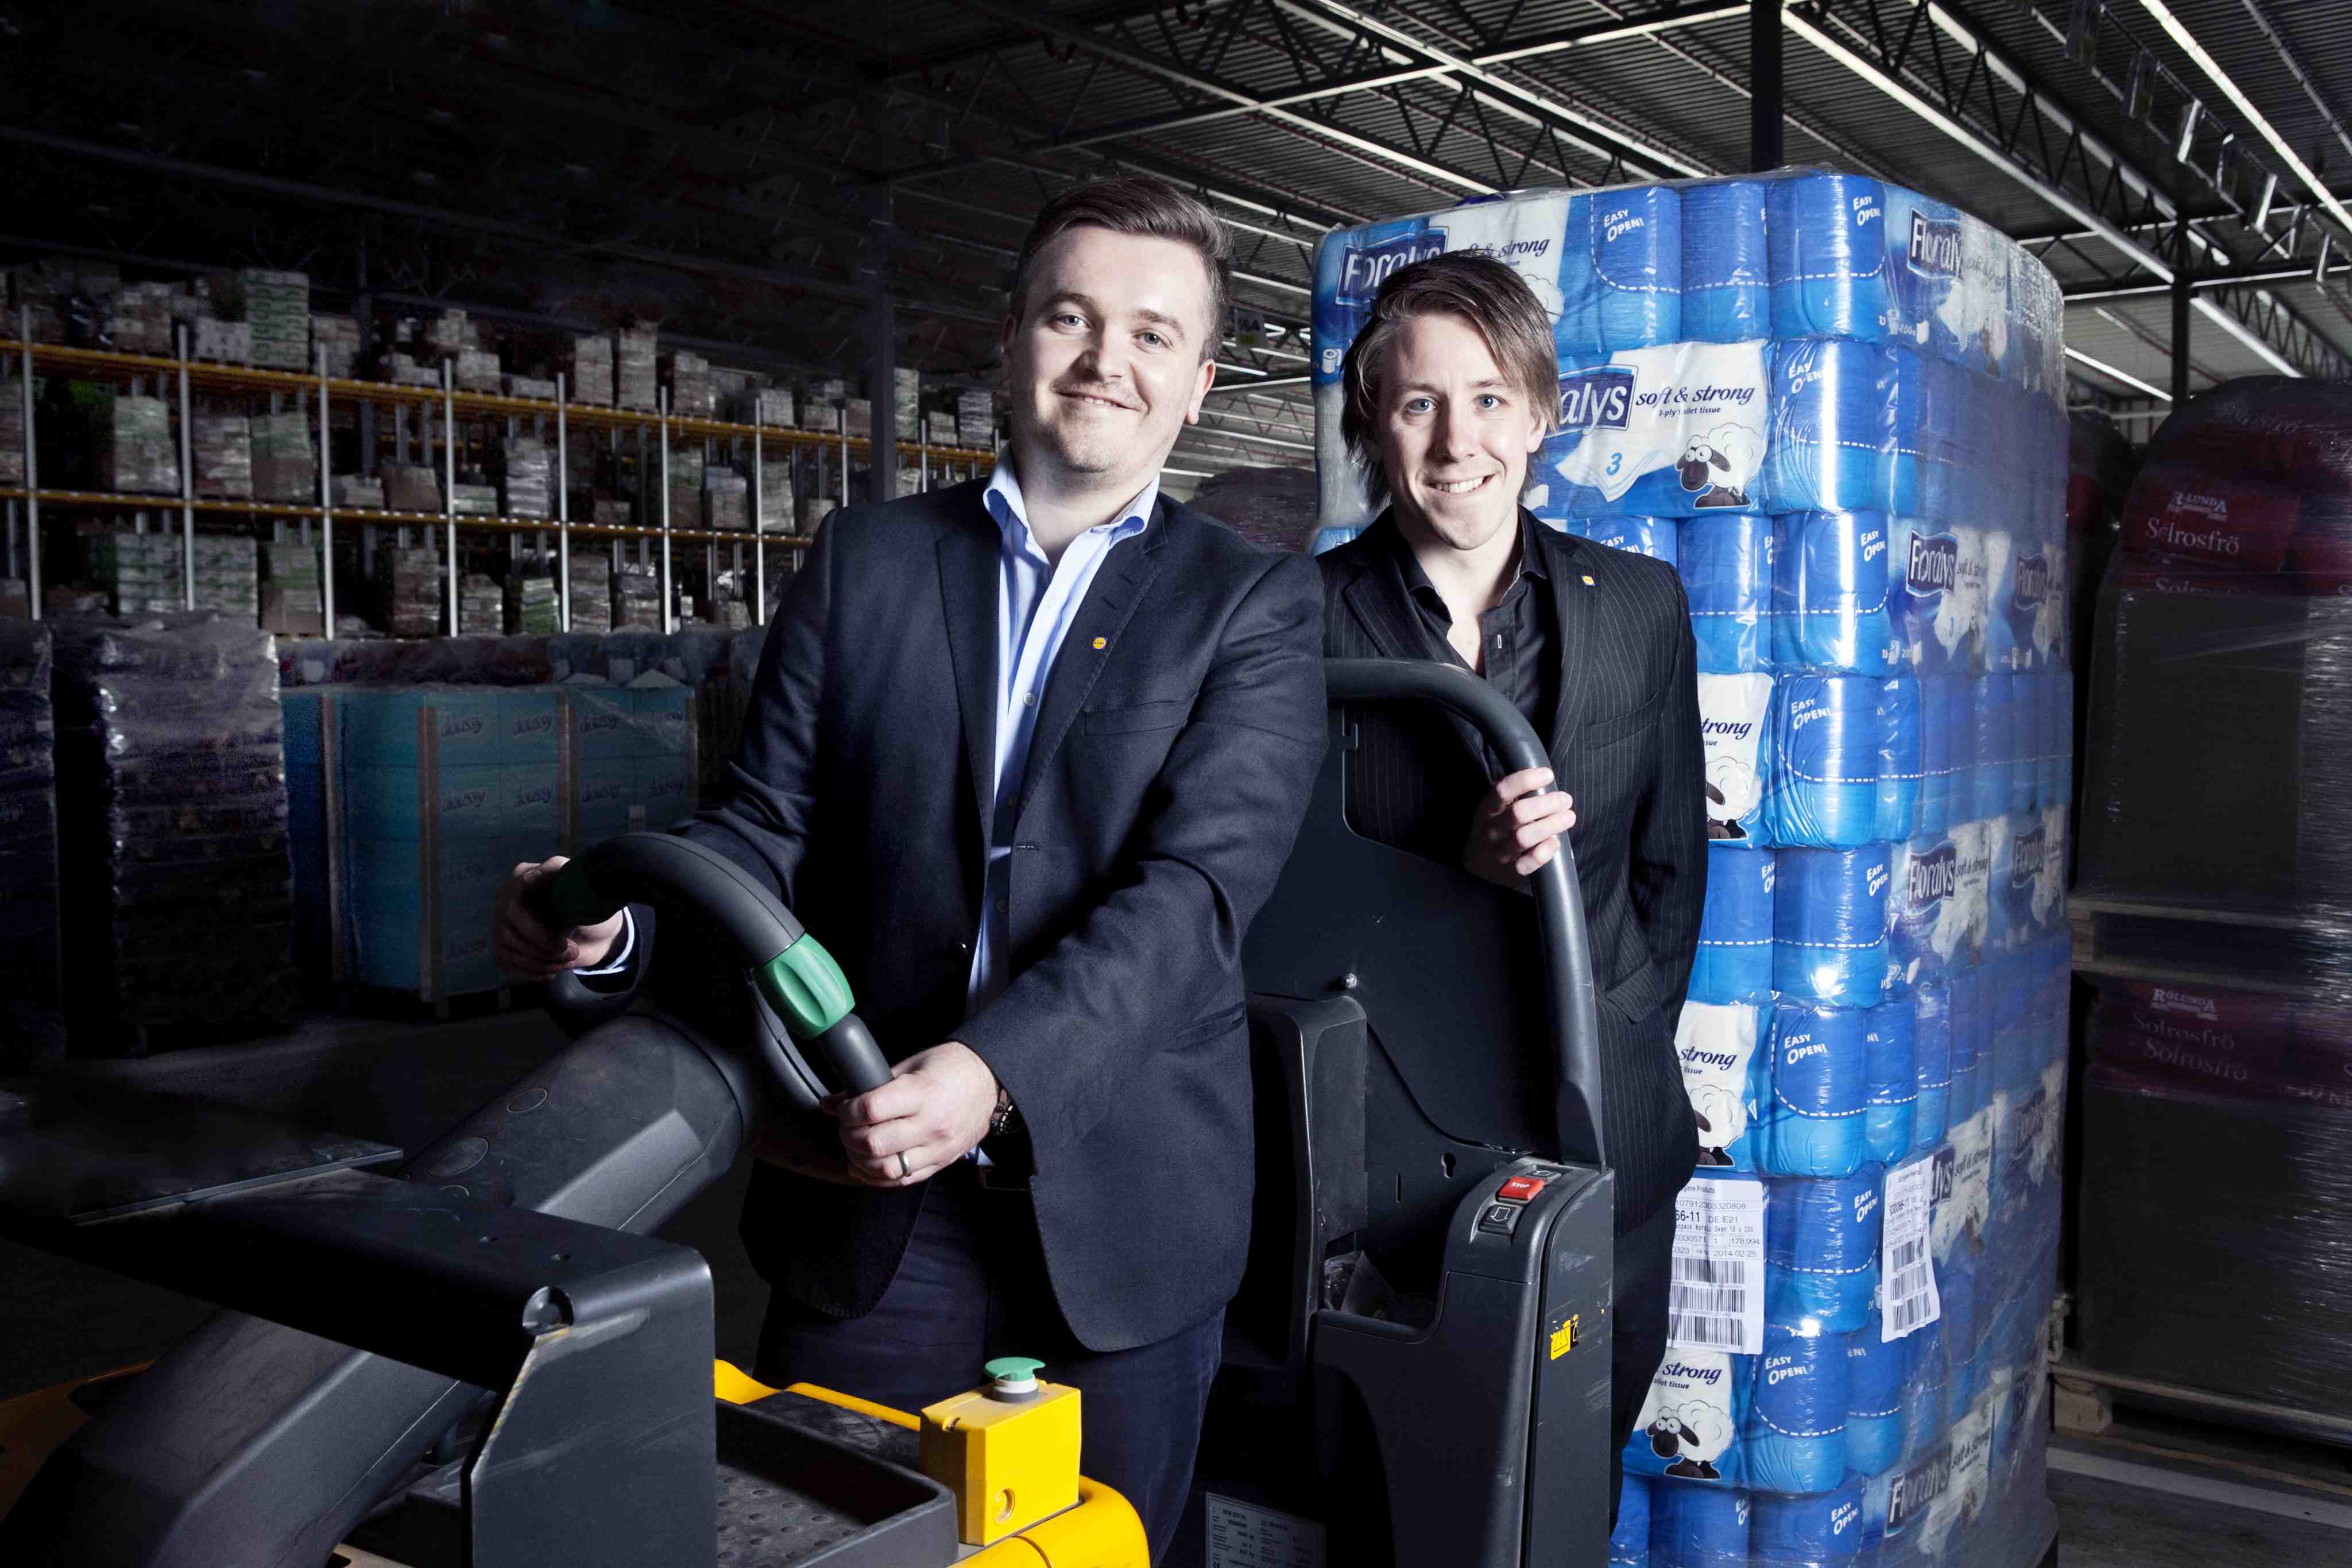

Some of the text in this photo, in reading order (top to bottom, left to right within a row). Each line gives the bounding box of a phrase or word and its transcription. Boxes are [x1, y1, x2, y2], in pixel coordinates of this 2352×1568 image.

[1604, 209, 1628, 228] EASY
[1607, 217, 1645, 242] OPEN!
[1498, 238, 1550, 258] strong
[1559, 382, 1755, 435] alys soft & strong
[1699, 406, 1722, 415] tissue
[1606, 452, 1623, 476] 3
[1910, 540, 1954, 594] Foralys
[1791, 698, 1815, 714] EASY
[1700, 718, 1752, 740] trong
[1908, 855, 1954, 901] Floralys
[1784, 1033, 1811, 1049] EASY
[1678, 1046, 1738, 1071] strong
[1787, 1043, 1827, 1065] OPEN!
[1662, 1361, 1722, 1385] strong
[1765, 1356, 1792, 1369] EASY
[1669, 1379, 1690, 1389] tissue
[1768, 1366, 1808, 1385] OPEN!
[1831, 1502, 1851, 1521] EASY
